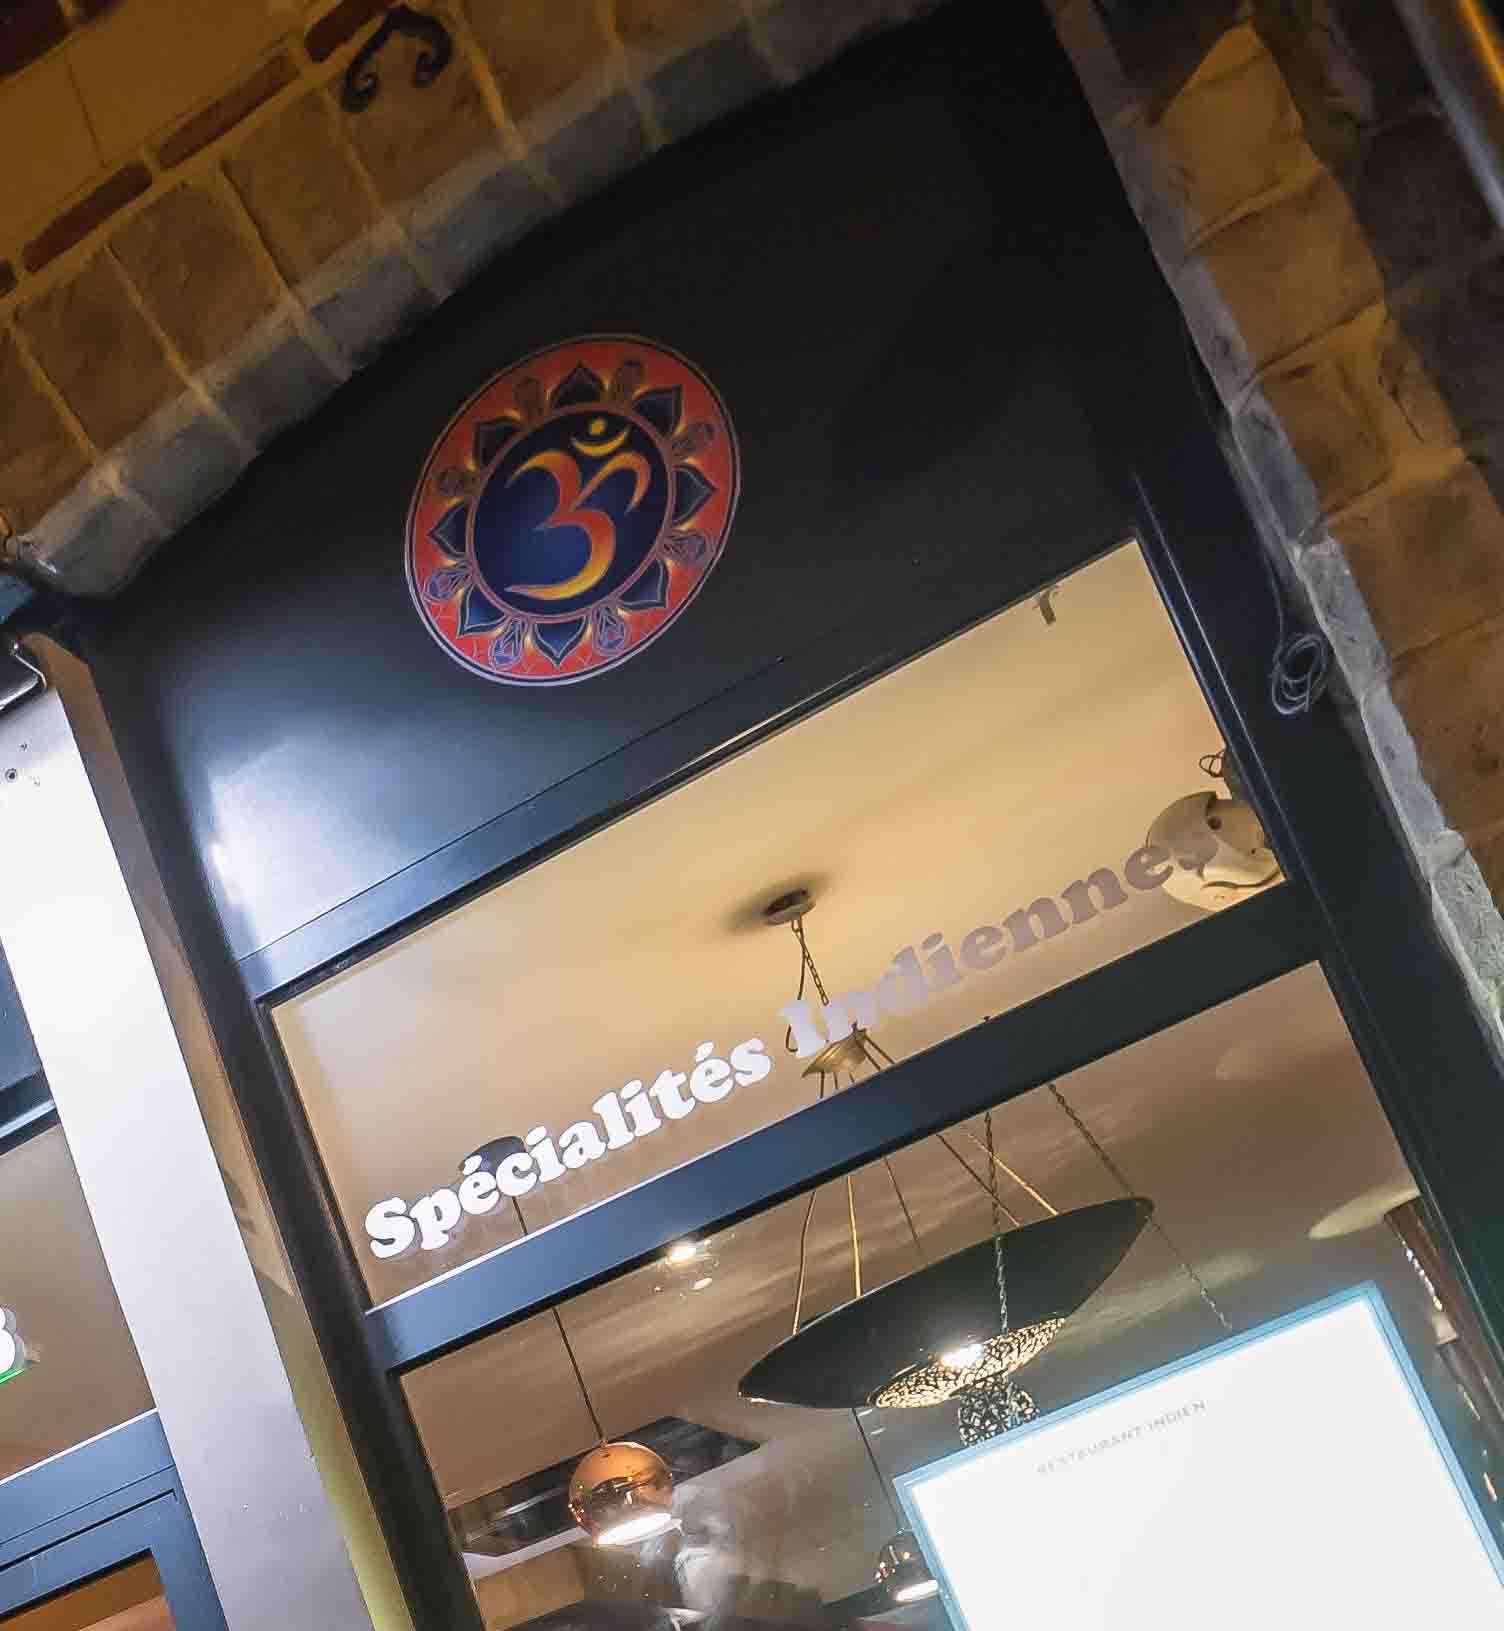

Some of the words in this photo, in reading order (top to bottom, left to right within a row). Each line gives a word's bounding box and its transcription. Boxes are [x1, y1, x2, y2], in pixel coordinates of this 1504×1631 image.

[363, 1030, 771, 1260] Spécialités
[778, 813, 1221, 1058] Indiennes
[1148, 1398, 1208, 1431] INDIEN
